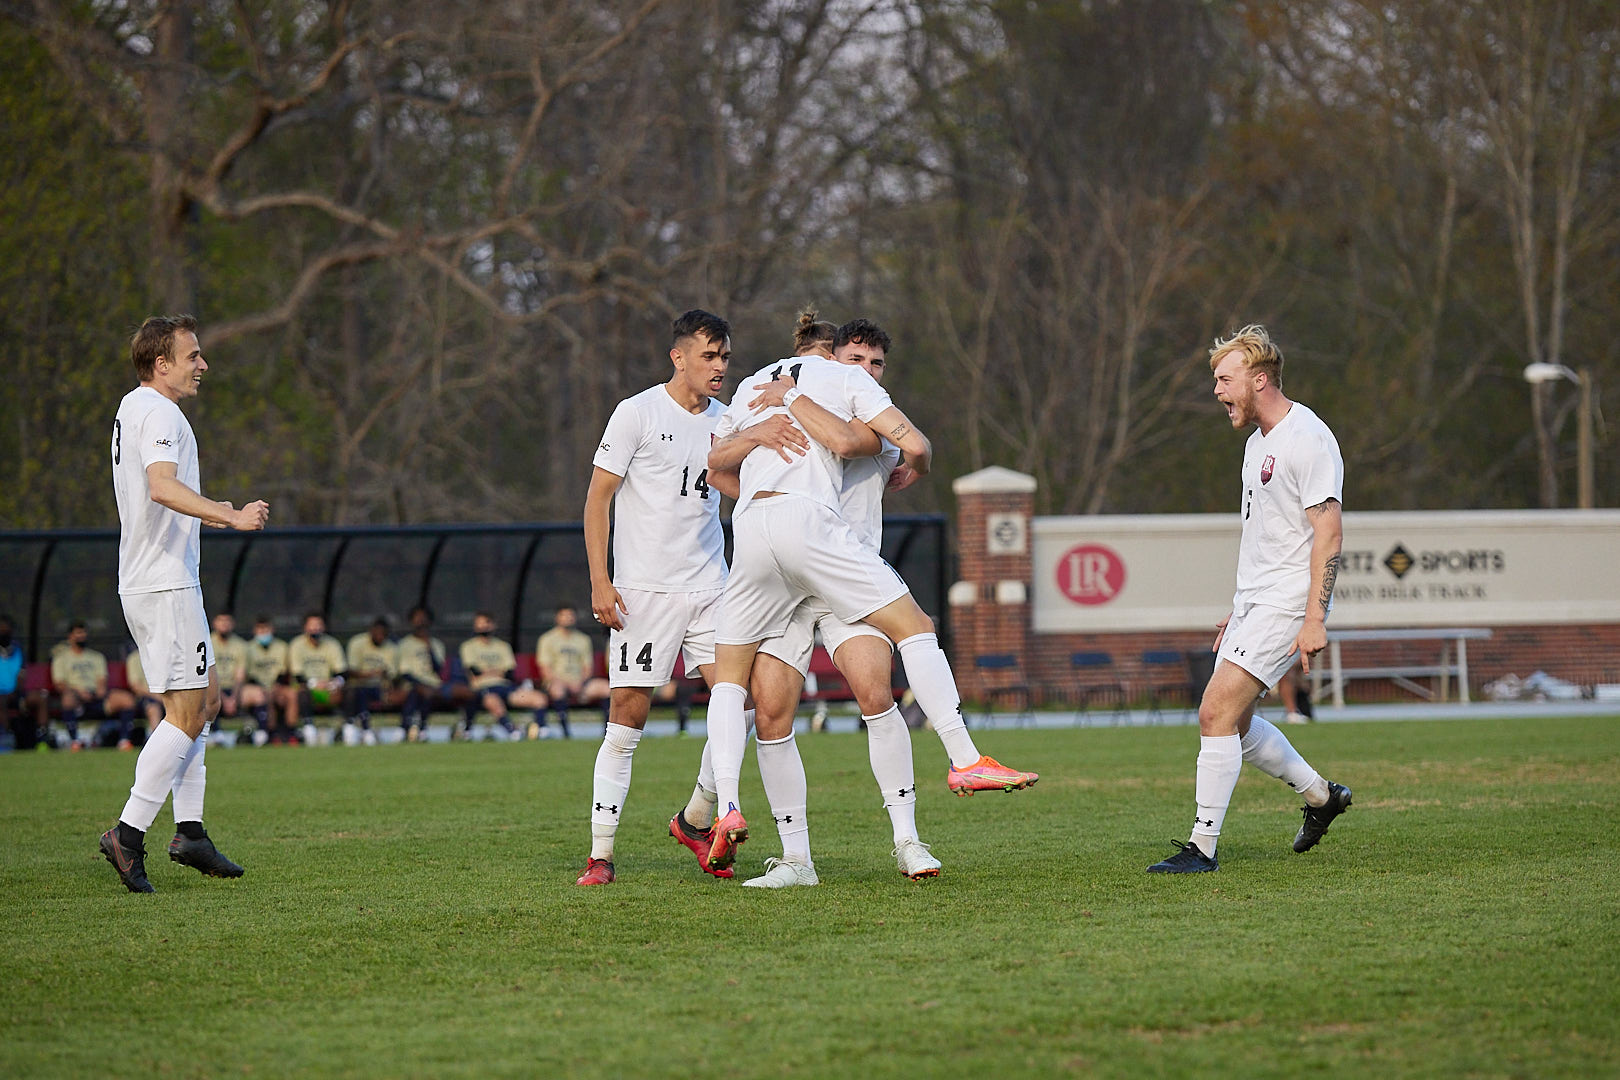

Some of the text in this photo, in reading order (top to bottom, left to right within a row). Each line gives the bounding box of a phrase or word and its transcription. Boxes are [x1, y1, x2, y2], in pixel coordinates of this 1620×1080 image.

[113, 418, 121, 466] 3
[680, 466, 709, 499] 14
[1069, 552, 1114, 597] LR
[1420, 550, 1504, 574] SPORTS
[1428, 585, 1488, 600] TRACK
[195, 641, 207, 676] 3
[618, 642, 653, 671] 14
